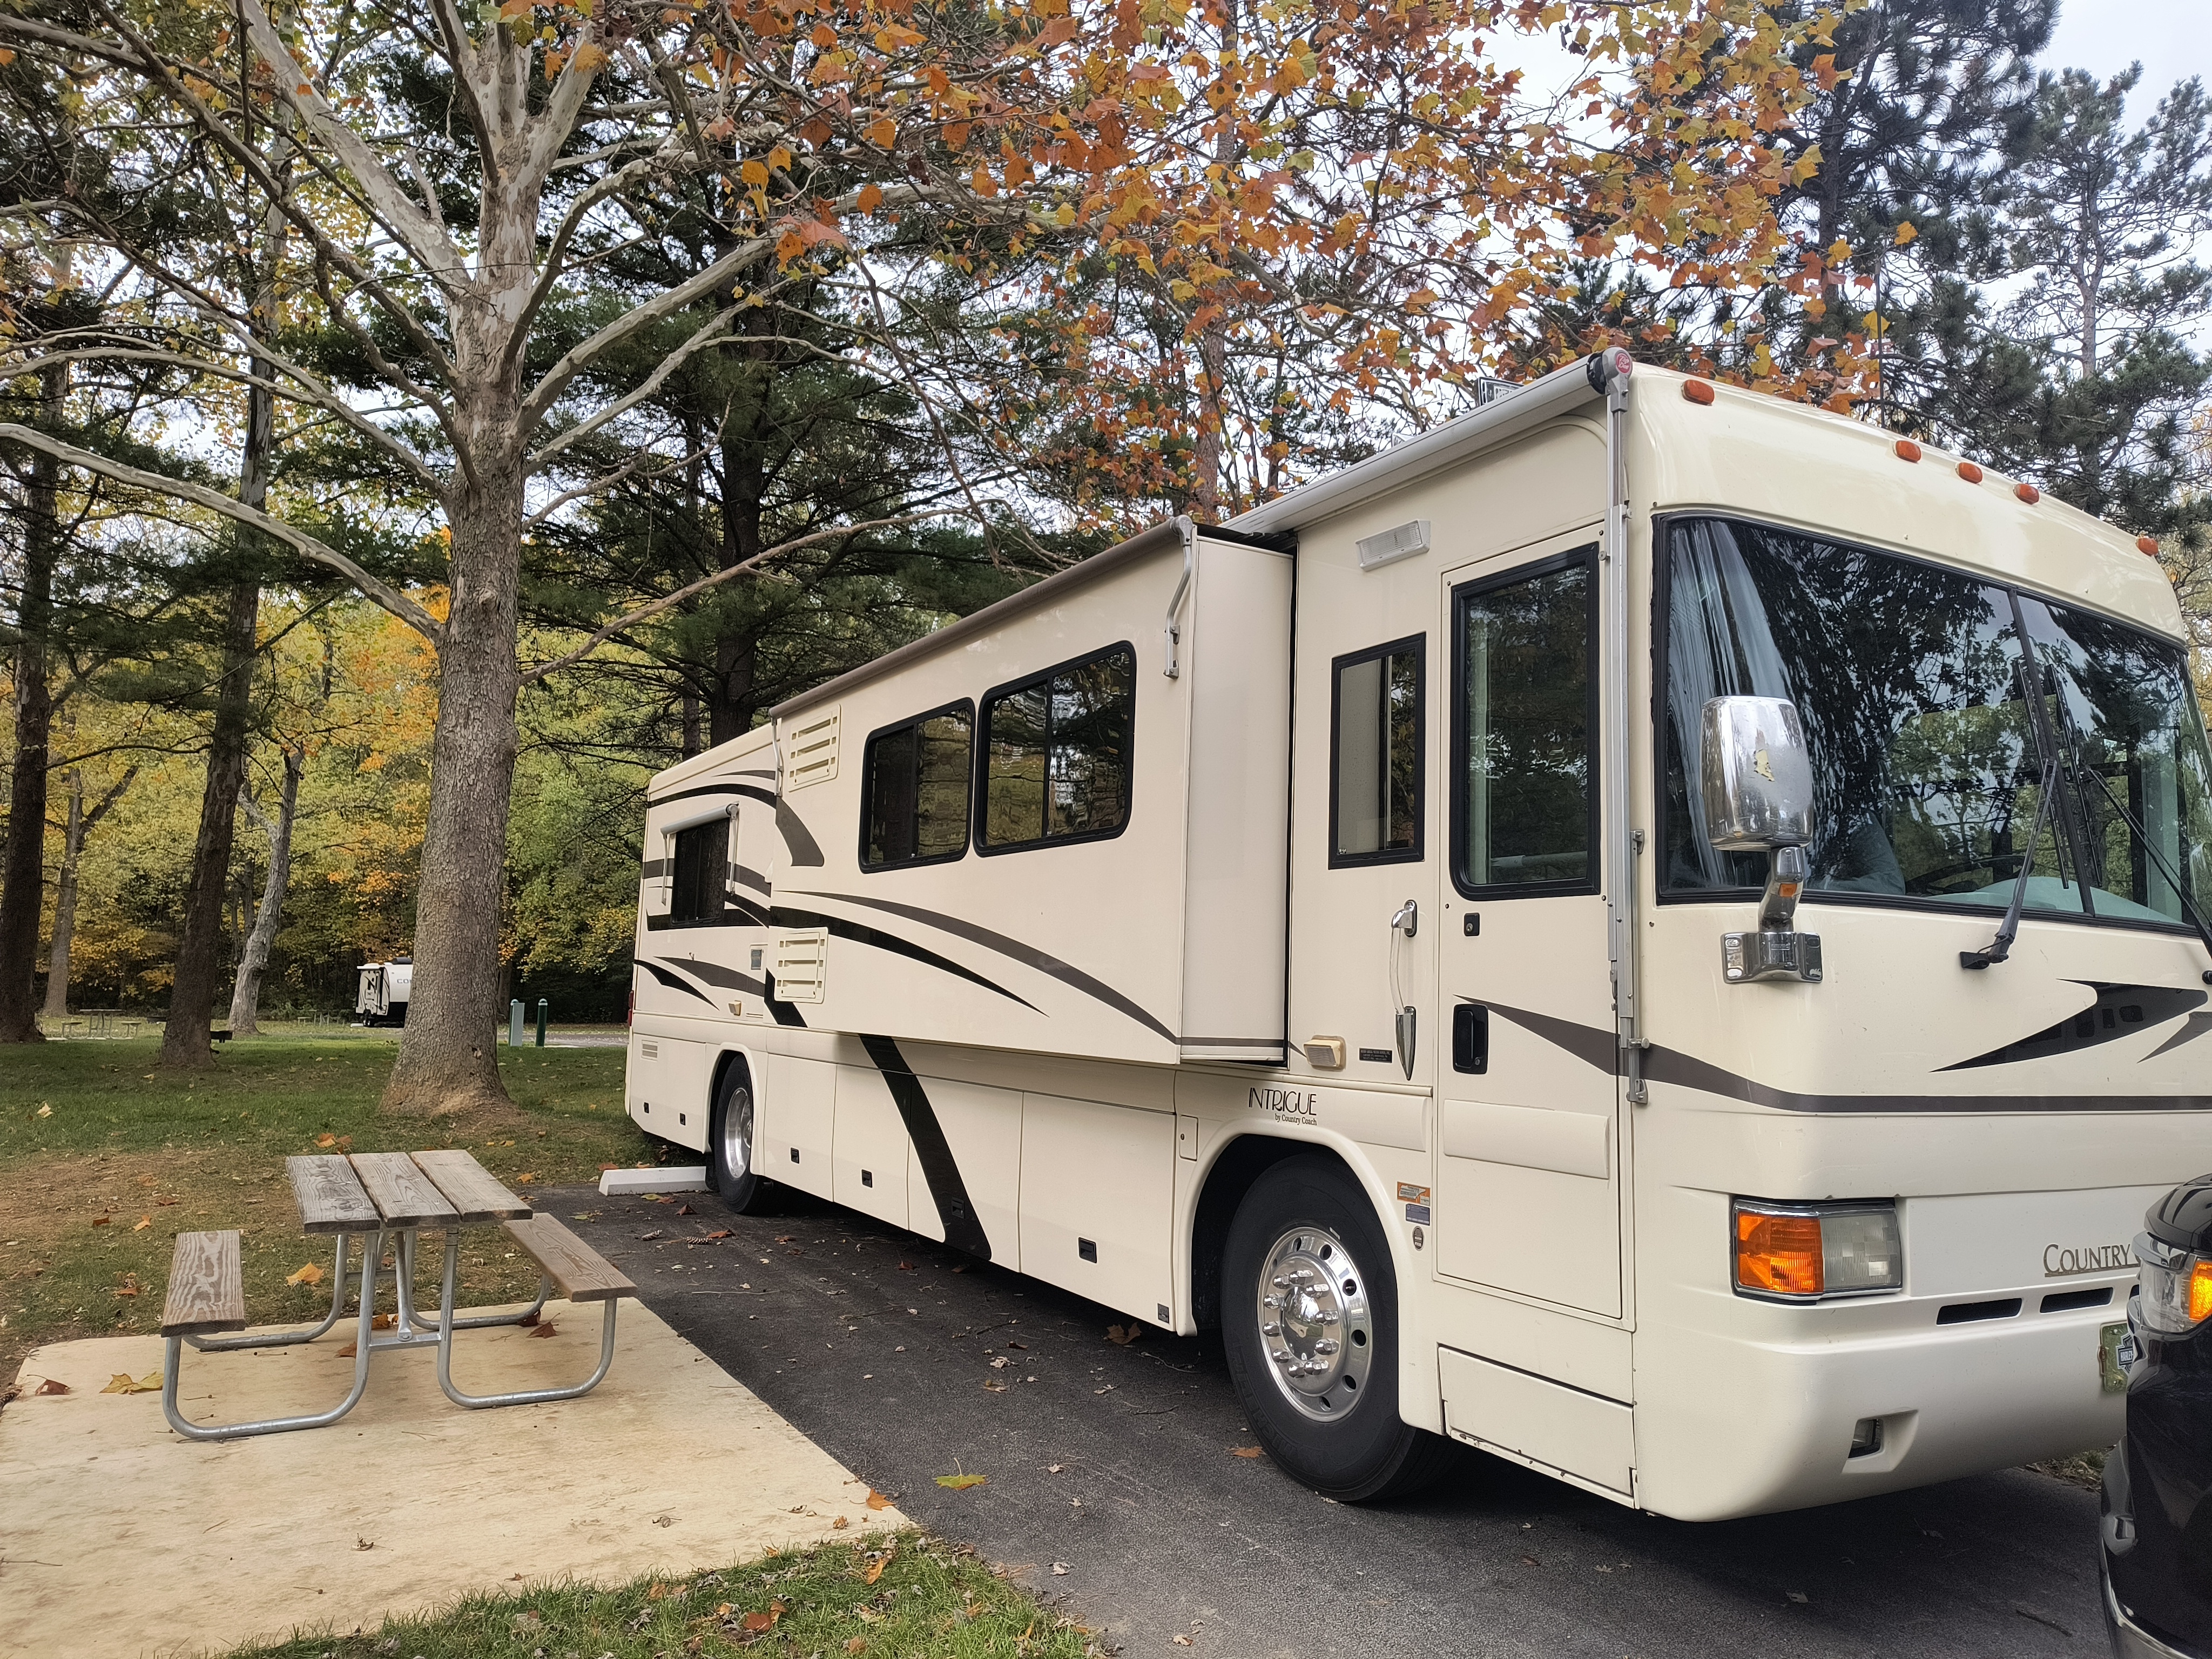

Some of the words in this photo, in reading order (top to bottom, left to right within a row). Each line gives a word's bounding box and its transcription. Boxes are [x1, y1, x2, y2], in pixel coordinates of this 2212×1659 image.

[1249, 1087, 1317, 1116] INTRIGUE
[1275, 1113, 1280, 1122] by
[1282, 1114, 1300, 1125] Country
[1302, 1117, 1317, 1125] Coach
